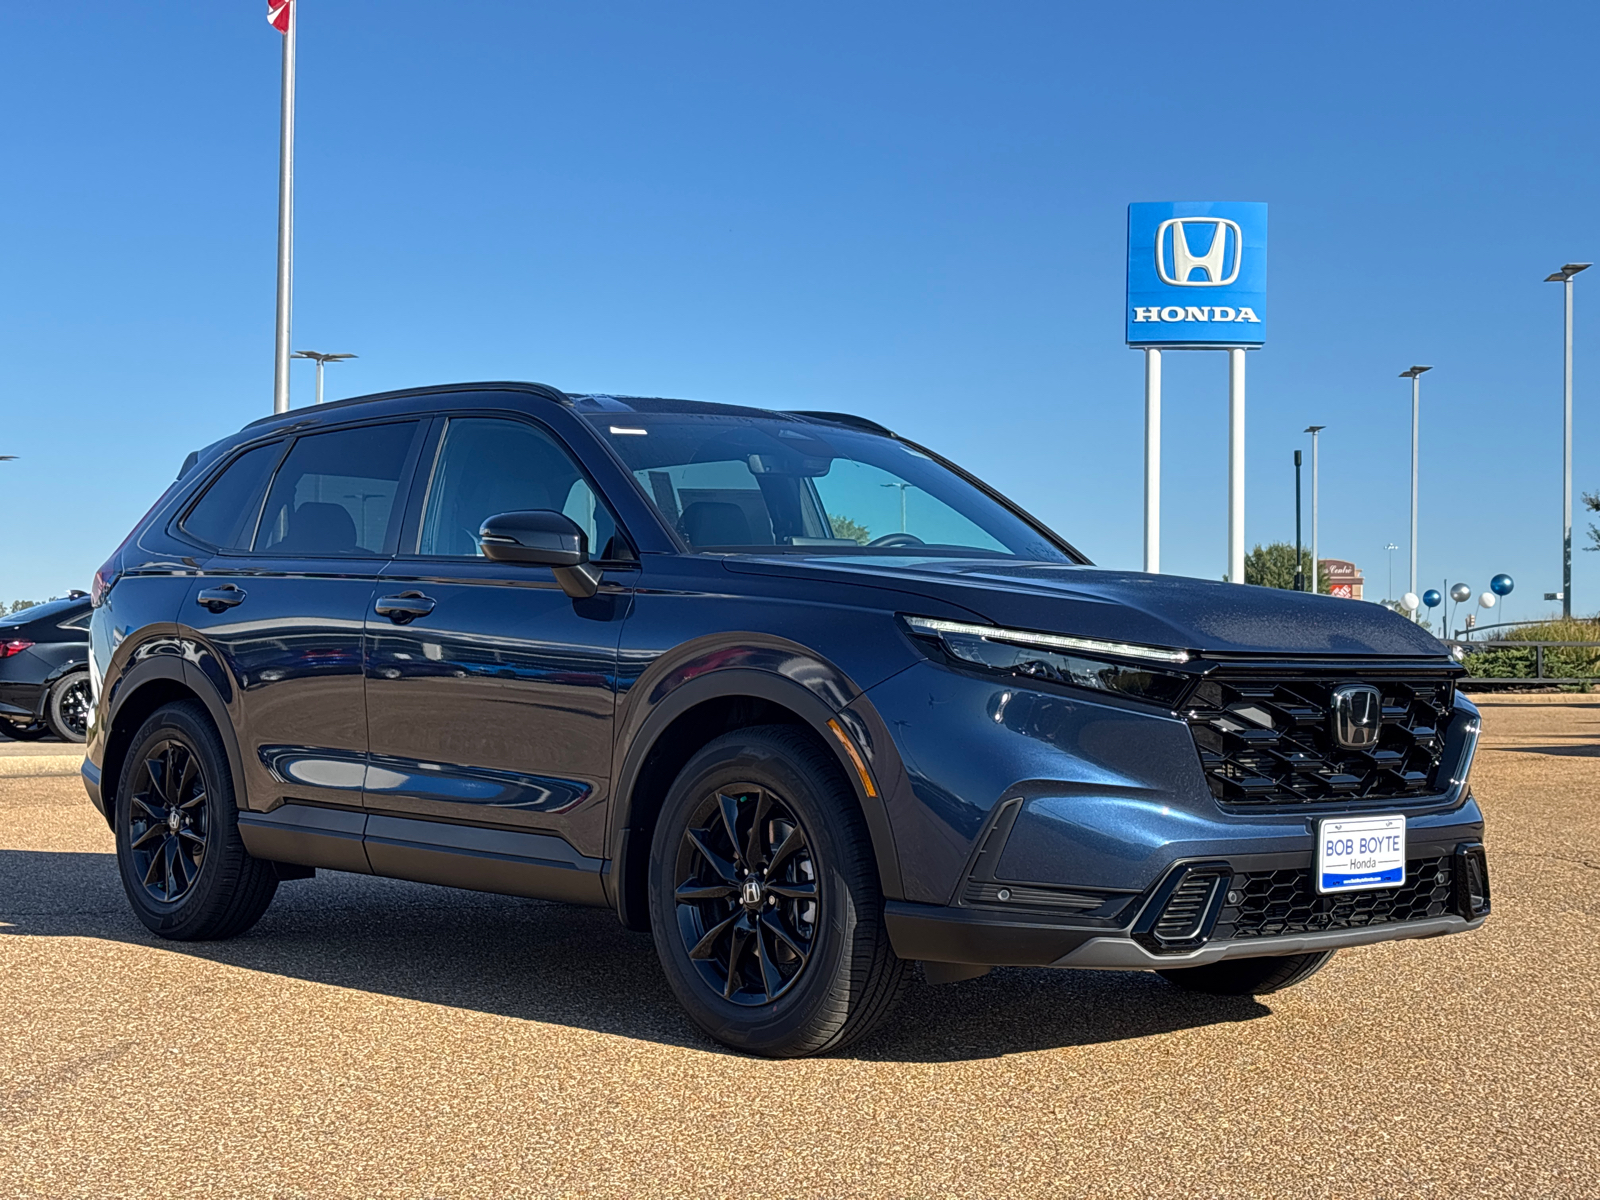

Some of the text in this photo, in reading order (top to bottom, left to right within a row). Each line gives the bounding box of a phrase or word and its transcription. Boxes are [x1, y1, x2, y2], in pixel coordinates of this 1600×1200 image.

[1133, 306, 1261, 322] HONDA
[1326, 835, 1400, 857] BOB BOYTE
[1350, 857, 1377, 870] Honda
